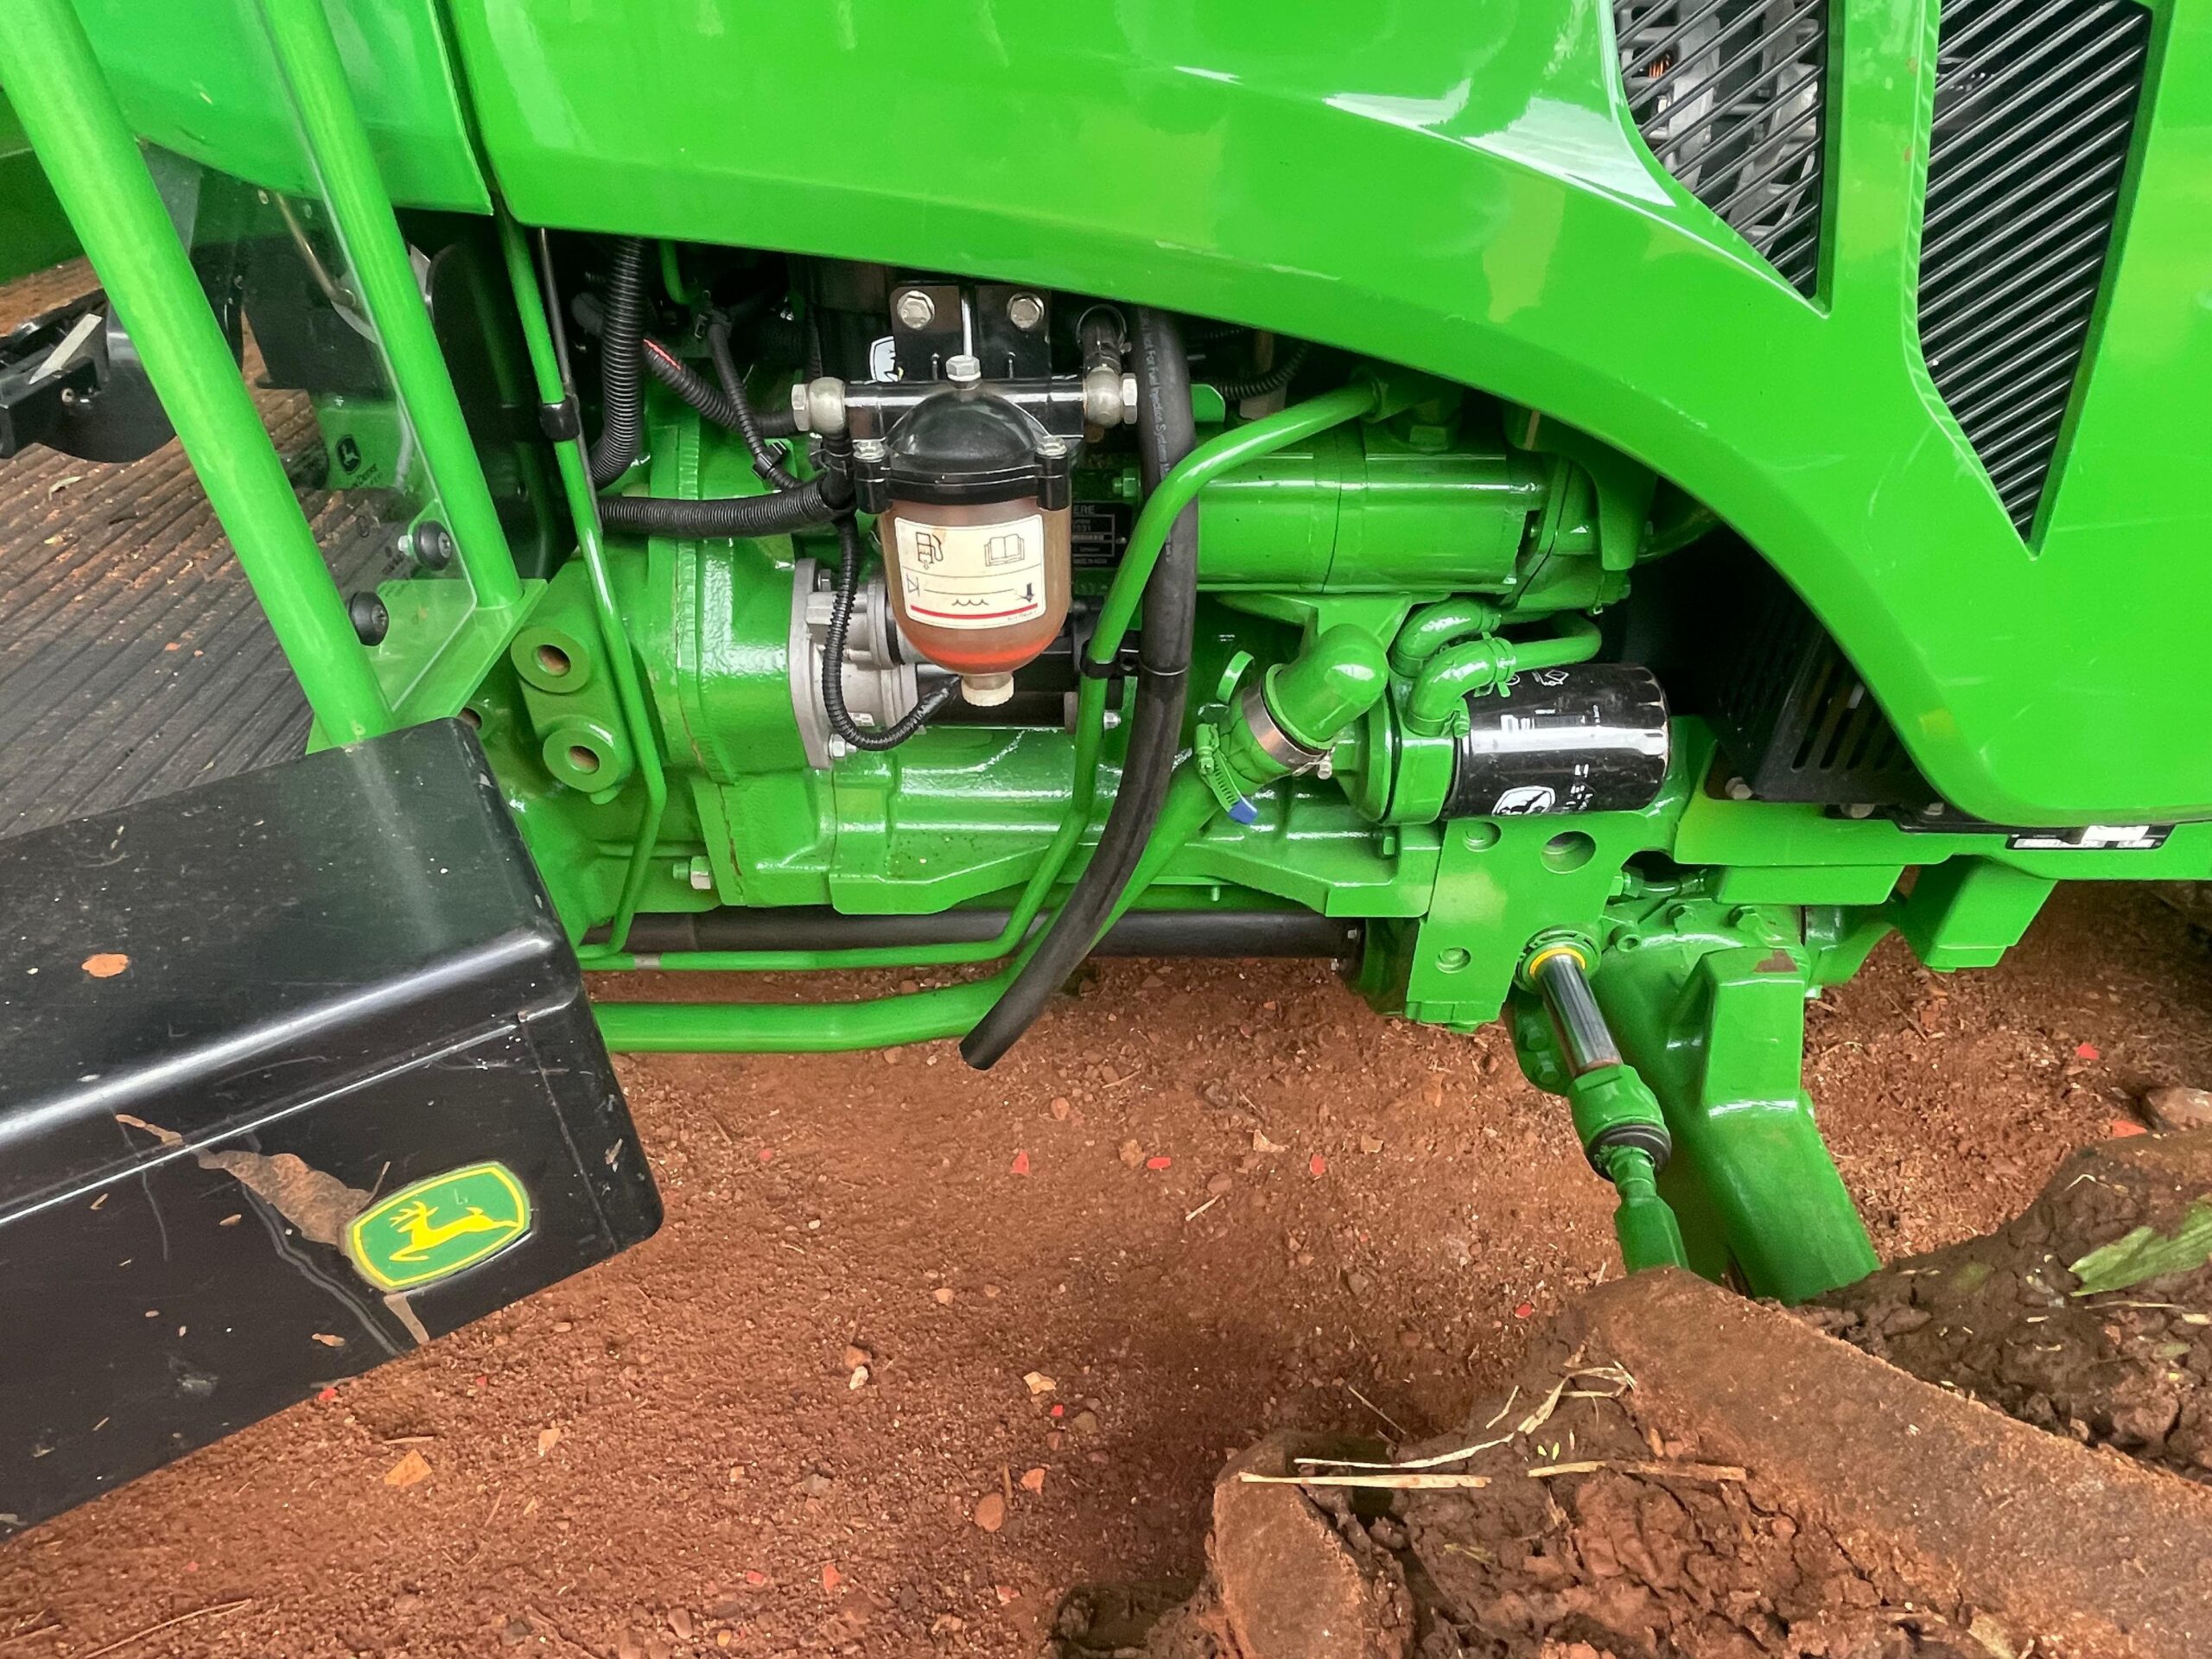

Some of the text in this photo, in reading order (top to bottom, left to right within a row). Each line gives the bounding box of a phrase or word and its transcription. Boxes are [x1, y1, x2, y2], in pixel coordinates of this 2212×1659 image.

[1146, 350, 1157, 365] For
[1148, 366, 1160, 386] Fuel
[1149, 386, 1163, 423] Injection
[1073, 505, 1096, 514] ERE
